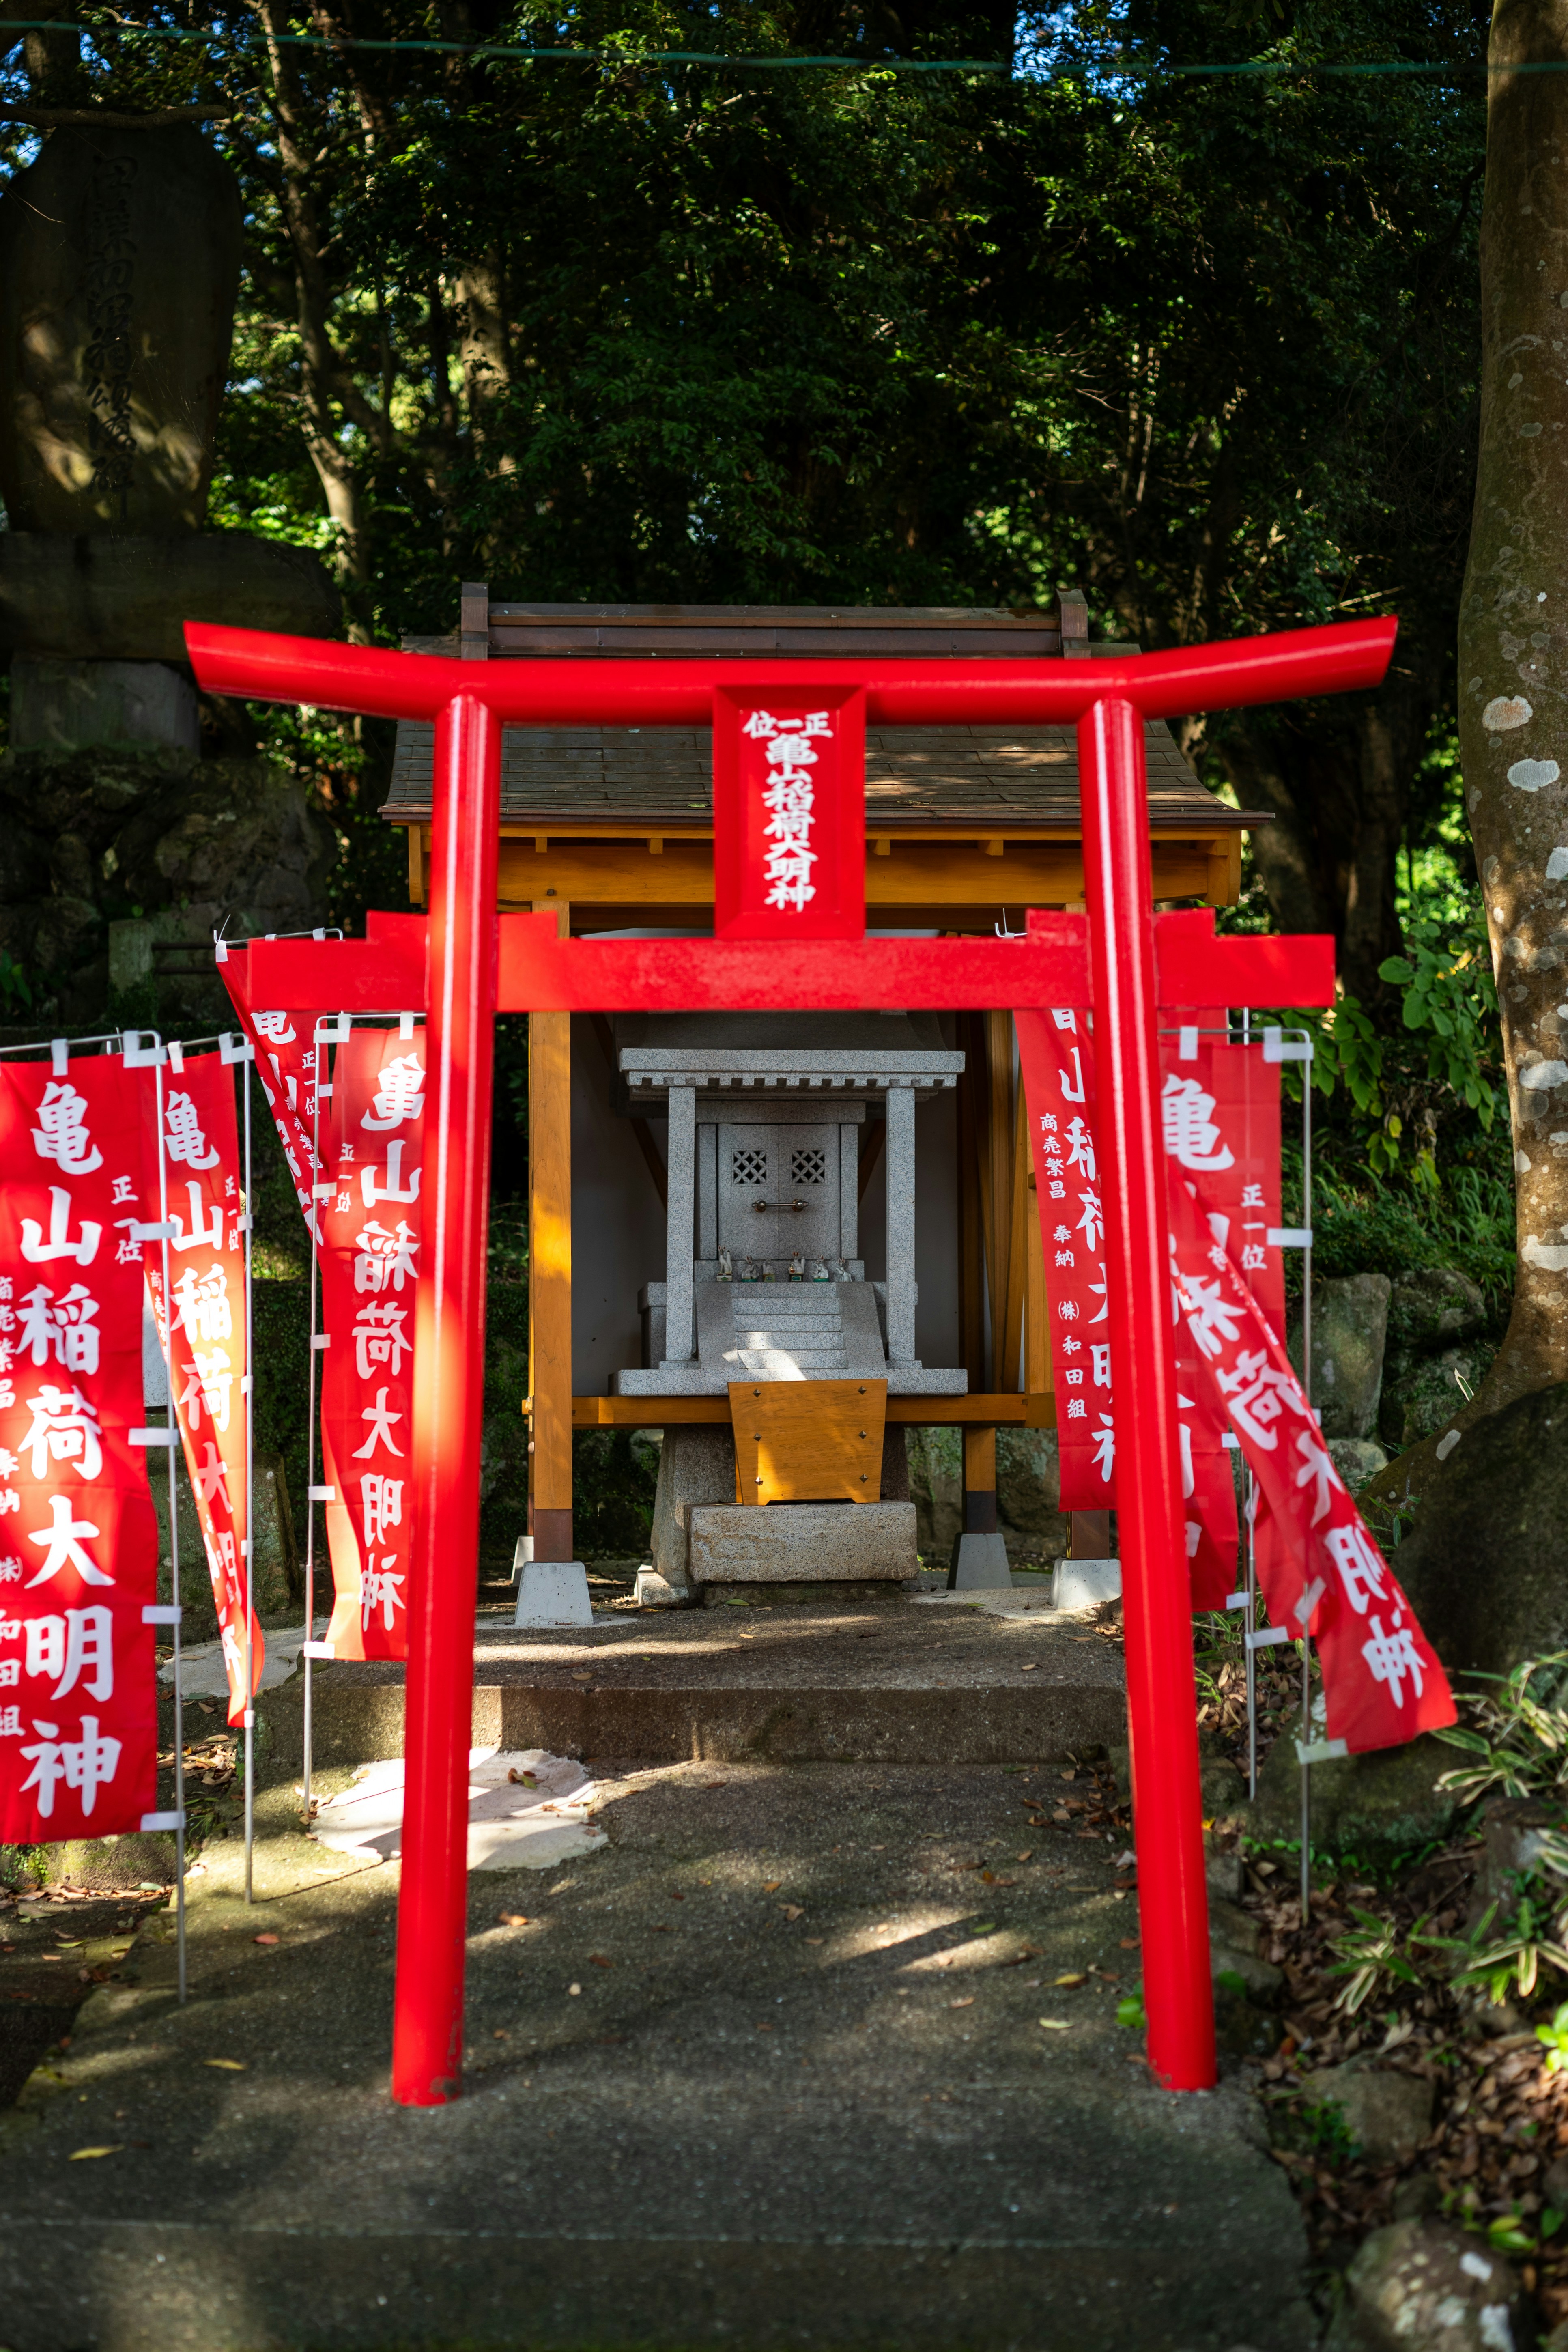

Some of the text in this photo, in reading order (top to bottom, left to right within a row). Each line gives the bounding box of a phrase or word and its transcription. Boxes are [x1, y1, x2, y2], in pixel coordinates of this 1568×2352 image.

[111, 1175, 143, 1265] 正一位
[225, 1175, 239, 1251] 正一位
[1039, 1113, 1066, 1199] 商売繁昌
[1053, 1224, 1075, 1267] 奉納
[1240, 1184, 1267, 1270] 正一位
[15, 1082, 123, 1818] 亀山稲荷大明神
[0, 1556, 26, 1737] 株)和田組
